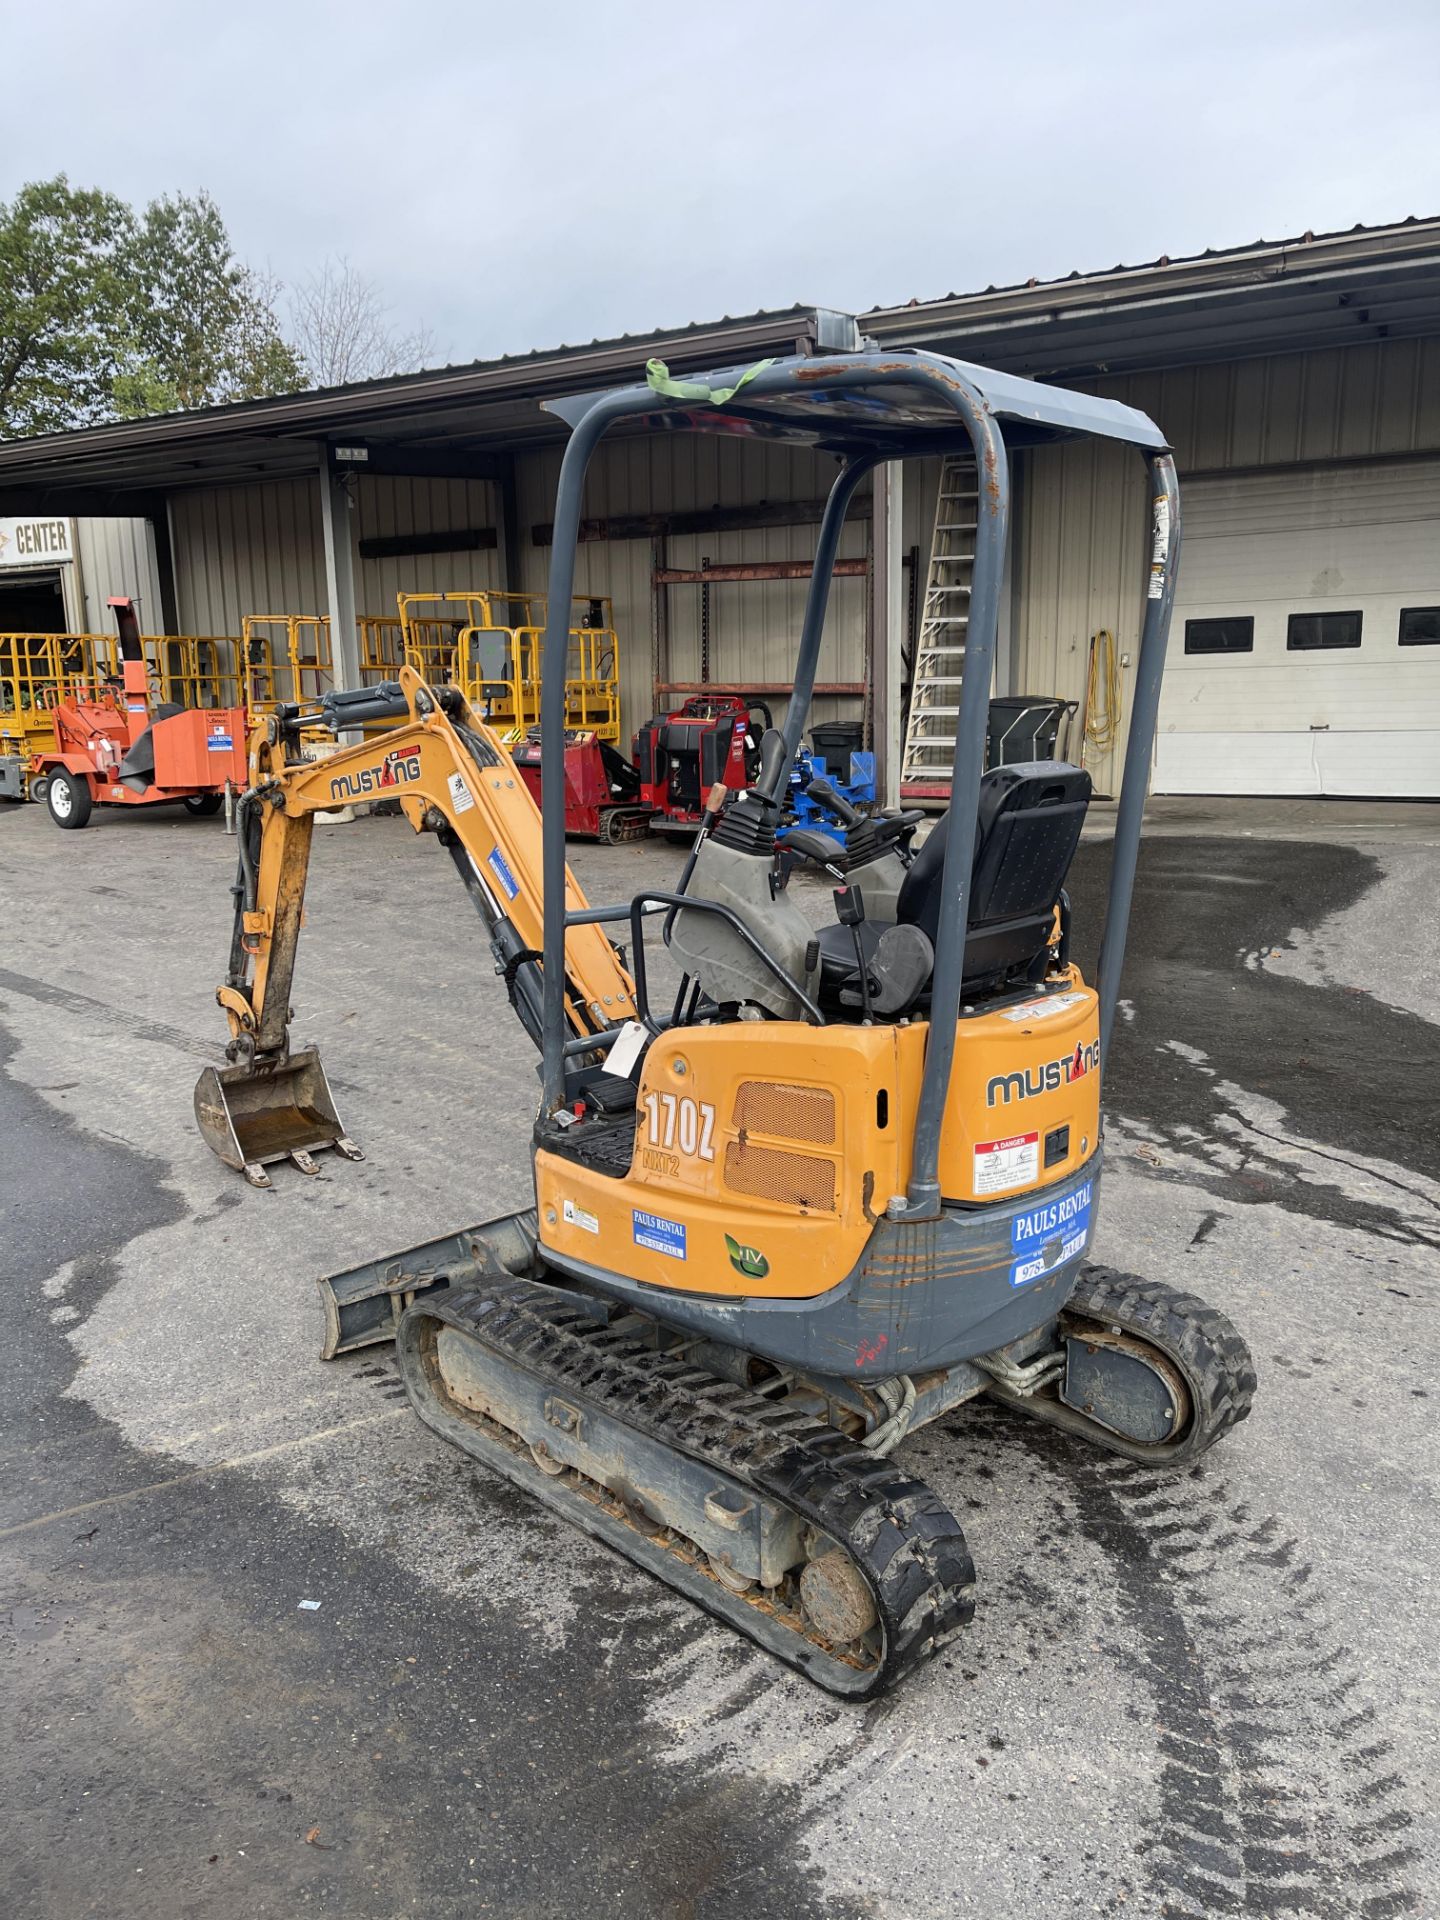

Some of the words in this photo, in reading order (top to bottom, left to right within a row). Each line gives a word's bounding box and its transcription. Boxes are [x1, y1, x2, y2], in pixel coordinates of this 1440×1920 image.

[16, 521, 67, 554] CENTER
[330, 757, 421, 800] MUSTANG
[643, 1089, 715, 1163] 170Z
[1000, 1138, 1026, 1149] DANGER
[643, 1148, 679, 1177] NXT2
[634, 1211, 655, 1229] PAULS
[657, 1218, 685, 1237] RENTAL
[1016, 1206, 1057, 1241] PAULS
[1058, 1184, 1091, 1224] RENTAL
